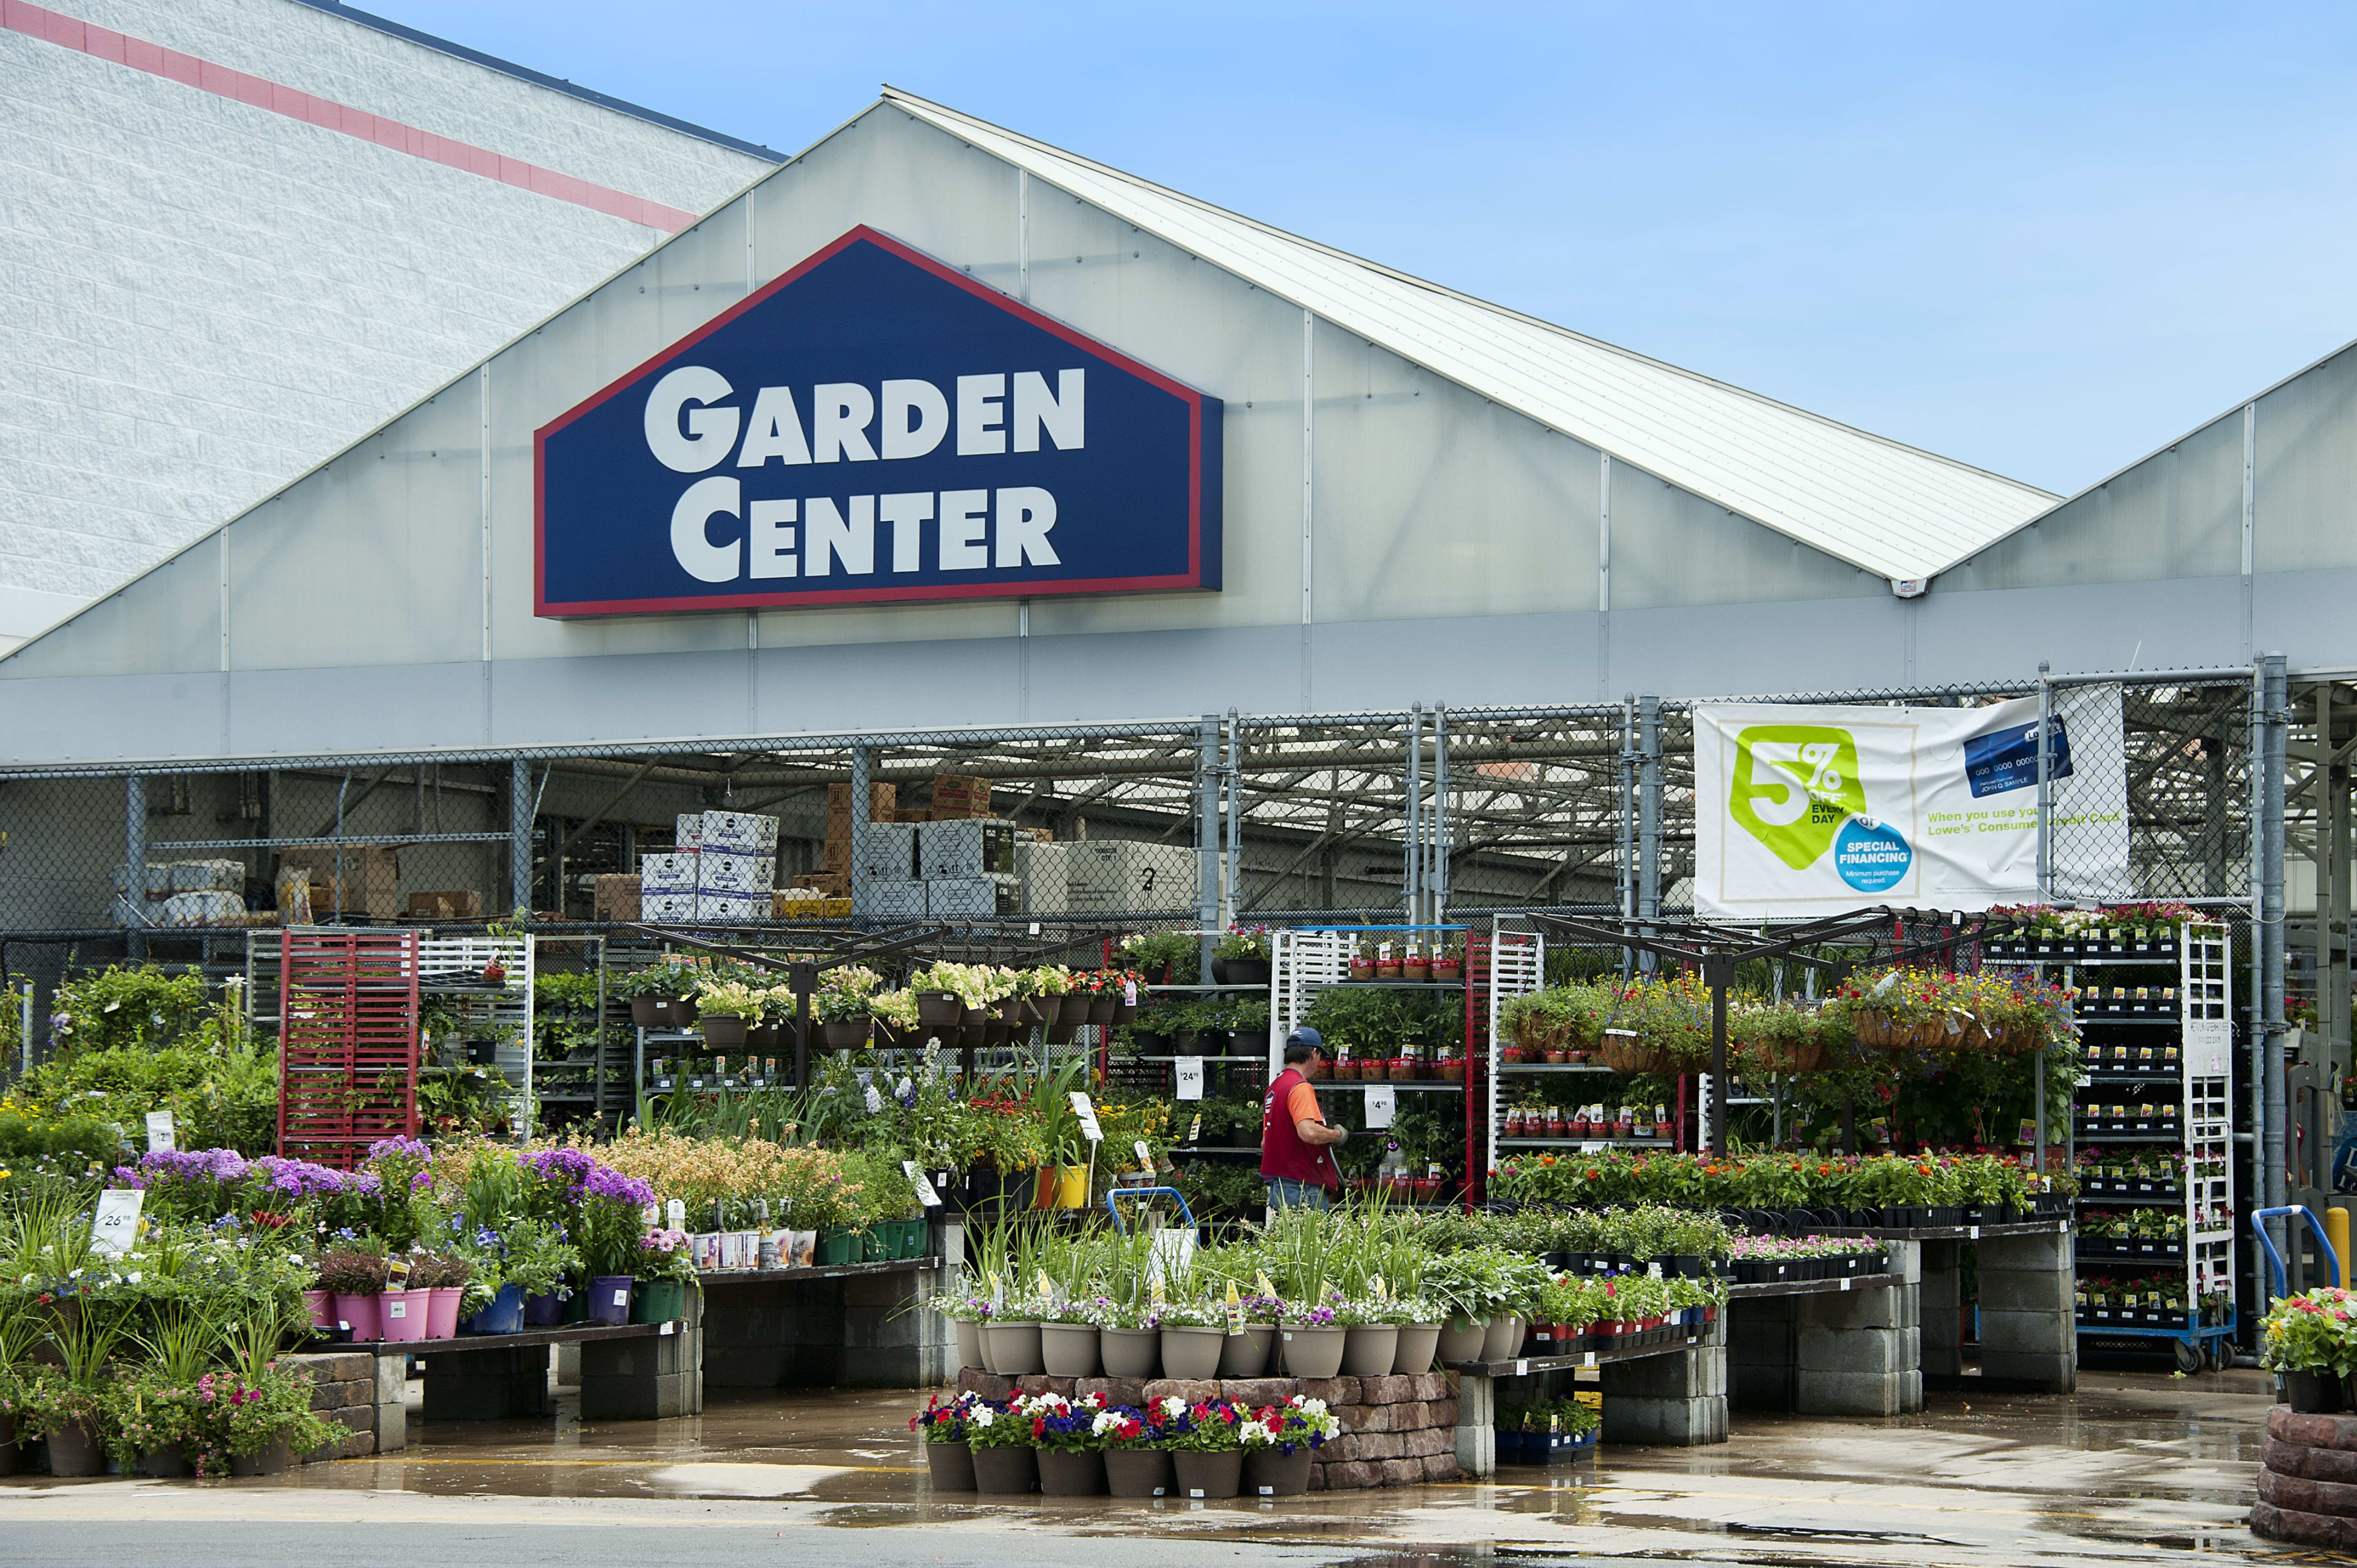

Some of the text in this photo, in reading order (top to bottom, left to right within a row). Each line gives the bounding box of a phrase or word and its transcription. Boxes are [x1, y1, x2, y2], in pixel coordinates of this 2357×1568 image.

[644, 365, 1085, 473] GARDEN
[670, 476, 1061, 583] CENTER
[1994, 762, 2013, 771] 0000
[2005, 777, 2028, 788] SAMPLE
[1812, 805, 1844, 814] EVERY
[1927, 807, 2038, 822] When you use you
[1812, 814, 1835, 824] DAY
[1859, 816, 1877, 827] or
[1978, 820, 2038, 832] Consume
[2089, 811, 2120, 823] Card
[1847, 841, 1900, 852] SPECIAL
